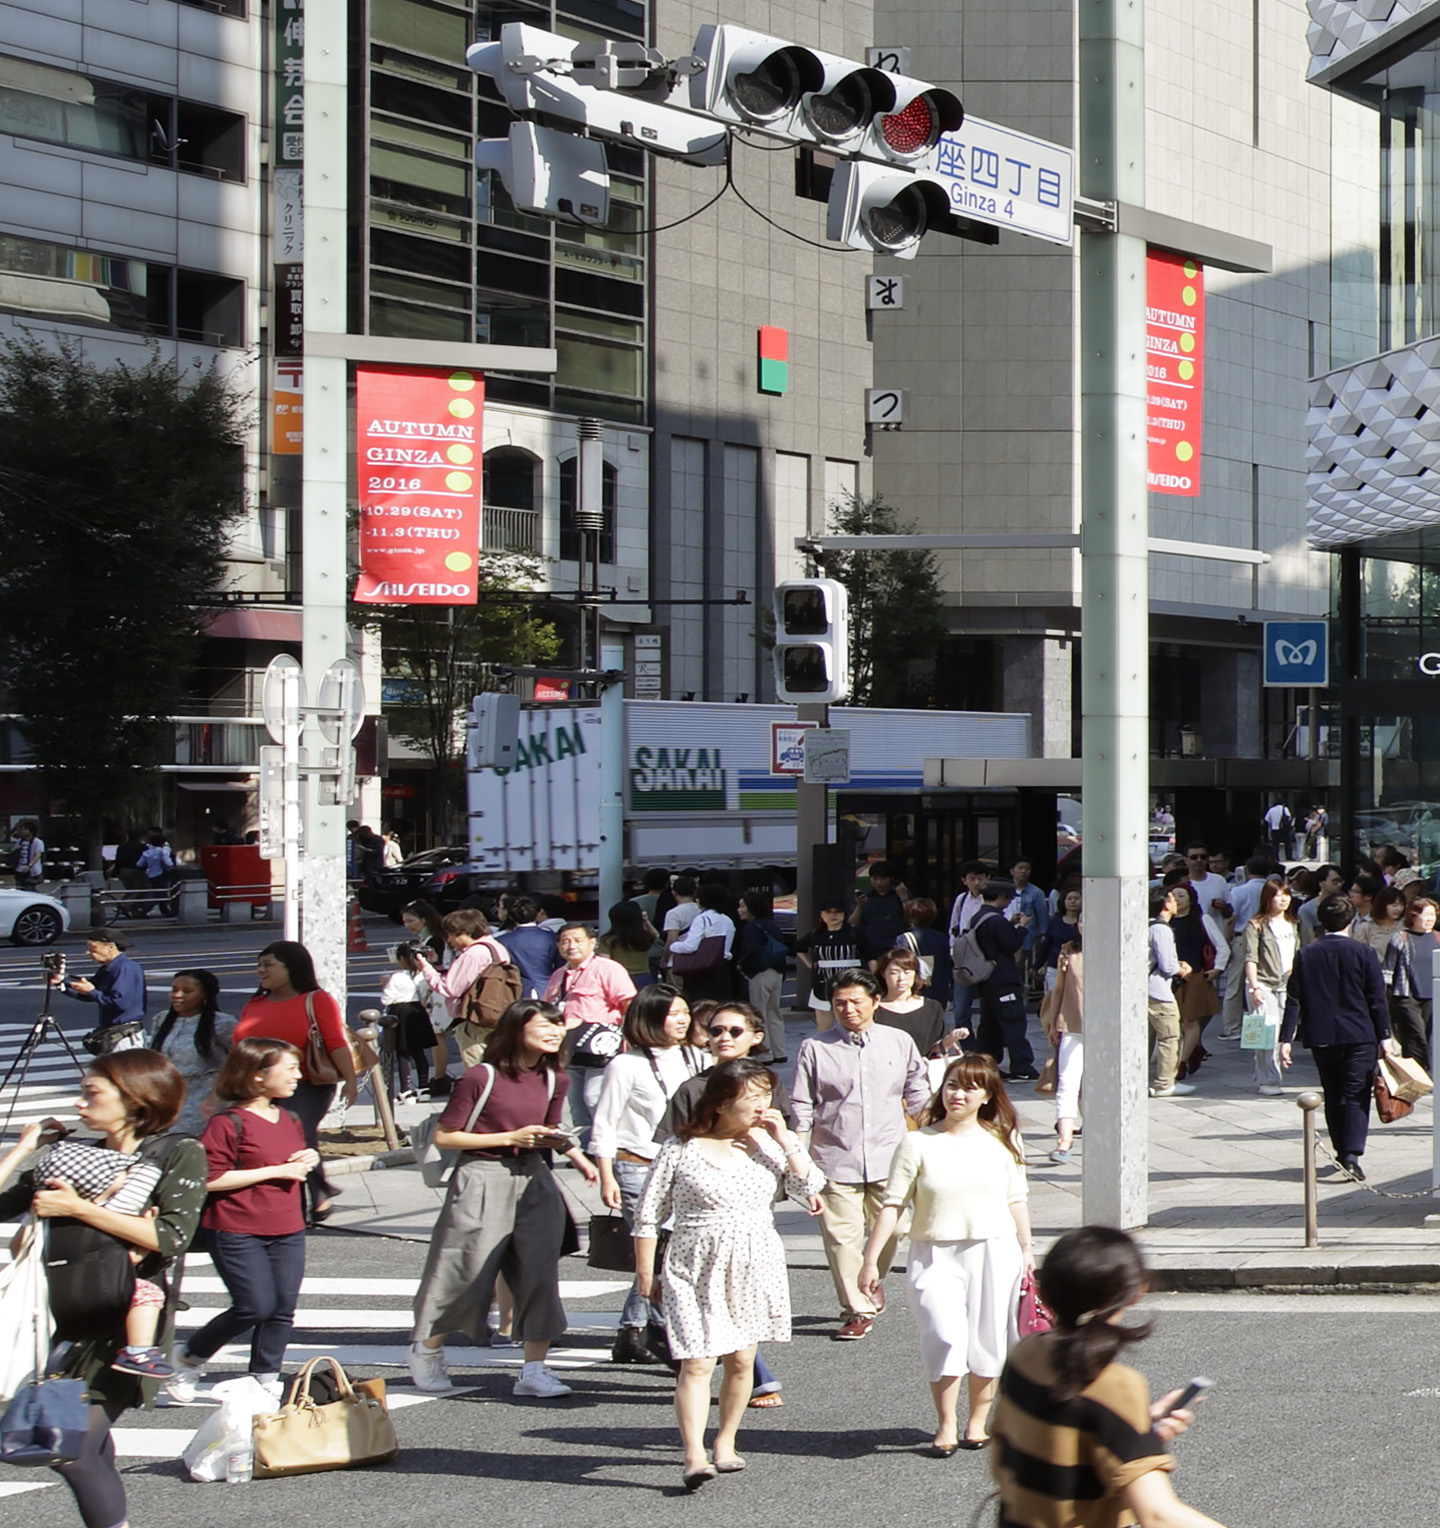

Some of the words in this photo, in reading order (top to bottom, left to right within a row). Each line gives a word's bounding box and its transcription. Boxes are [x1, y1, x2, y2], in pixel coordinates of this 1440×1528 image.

[926, 137, 1060, 208] 座四丁目
[950, 182, 996, 214] Ginza
[1003, 200, 1015, 220] 4
[1147, 365, 1167, 379] 016
[367, 419, 475, 439] AUTUMN
[366, 447, 444, 464] GINZA
[368, 477, 421, 490] 2016
[363, 581, 470, 597] SHISEIDO
[491, 722, 587, 777] AKAI
